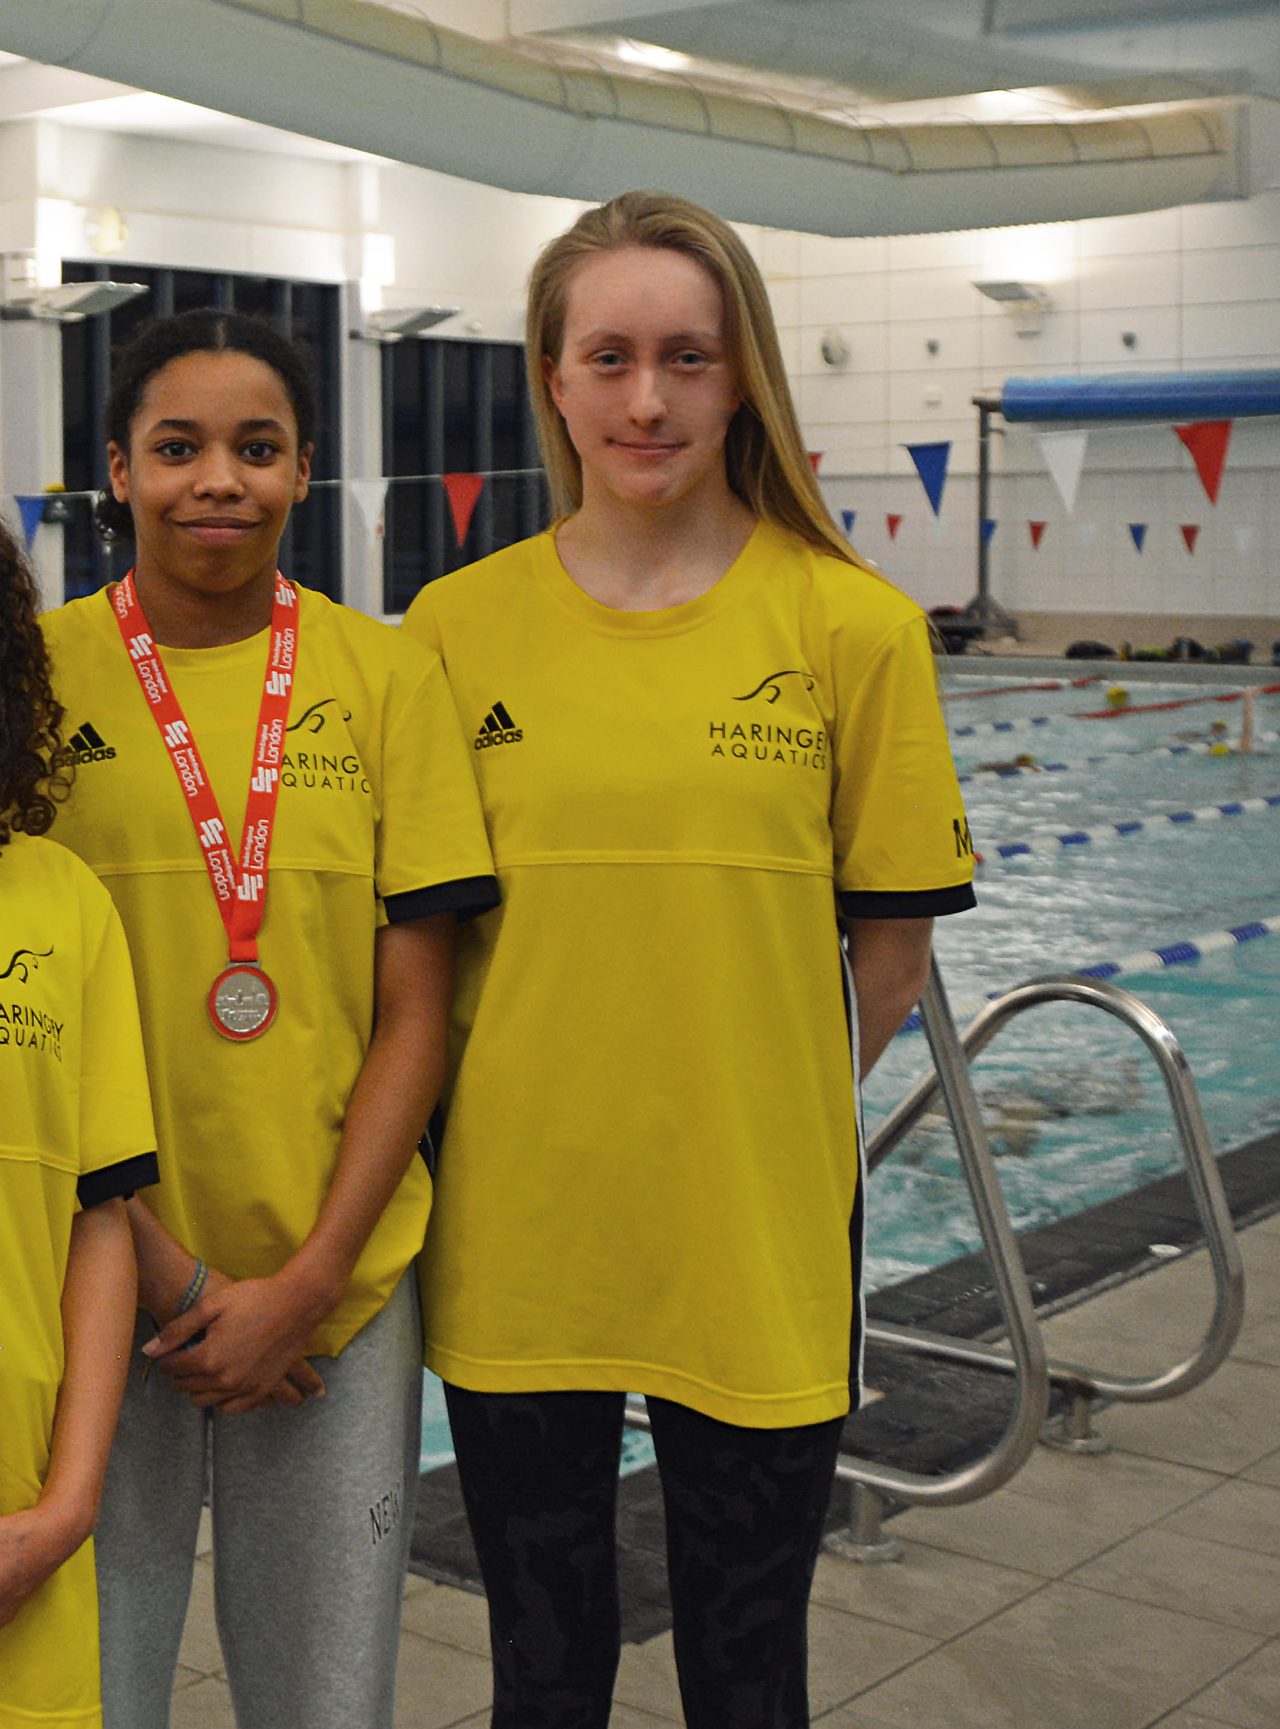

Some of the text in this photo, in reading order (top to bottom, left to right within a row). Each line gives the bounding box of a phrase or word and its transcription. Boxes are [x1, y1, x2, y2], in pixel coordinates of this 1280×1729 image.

[279, 627, 295, 670] London
[137, 660, 162, 704] London
[264, 718, 283, 764] London
[474, 728, 523, 750] adidas
[709, 721, 828, 751] HARINGE
[173, 749, 199, 797] London
[282, 753, 359, 774] ARING
[282, 772, 371, 794] QUATIC
[249, 819, 269, 869] London
[208, 850, 230, 900] London
